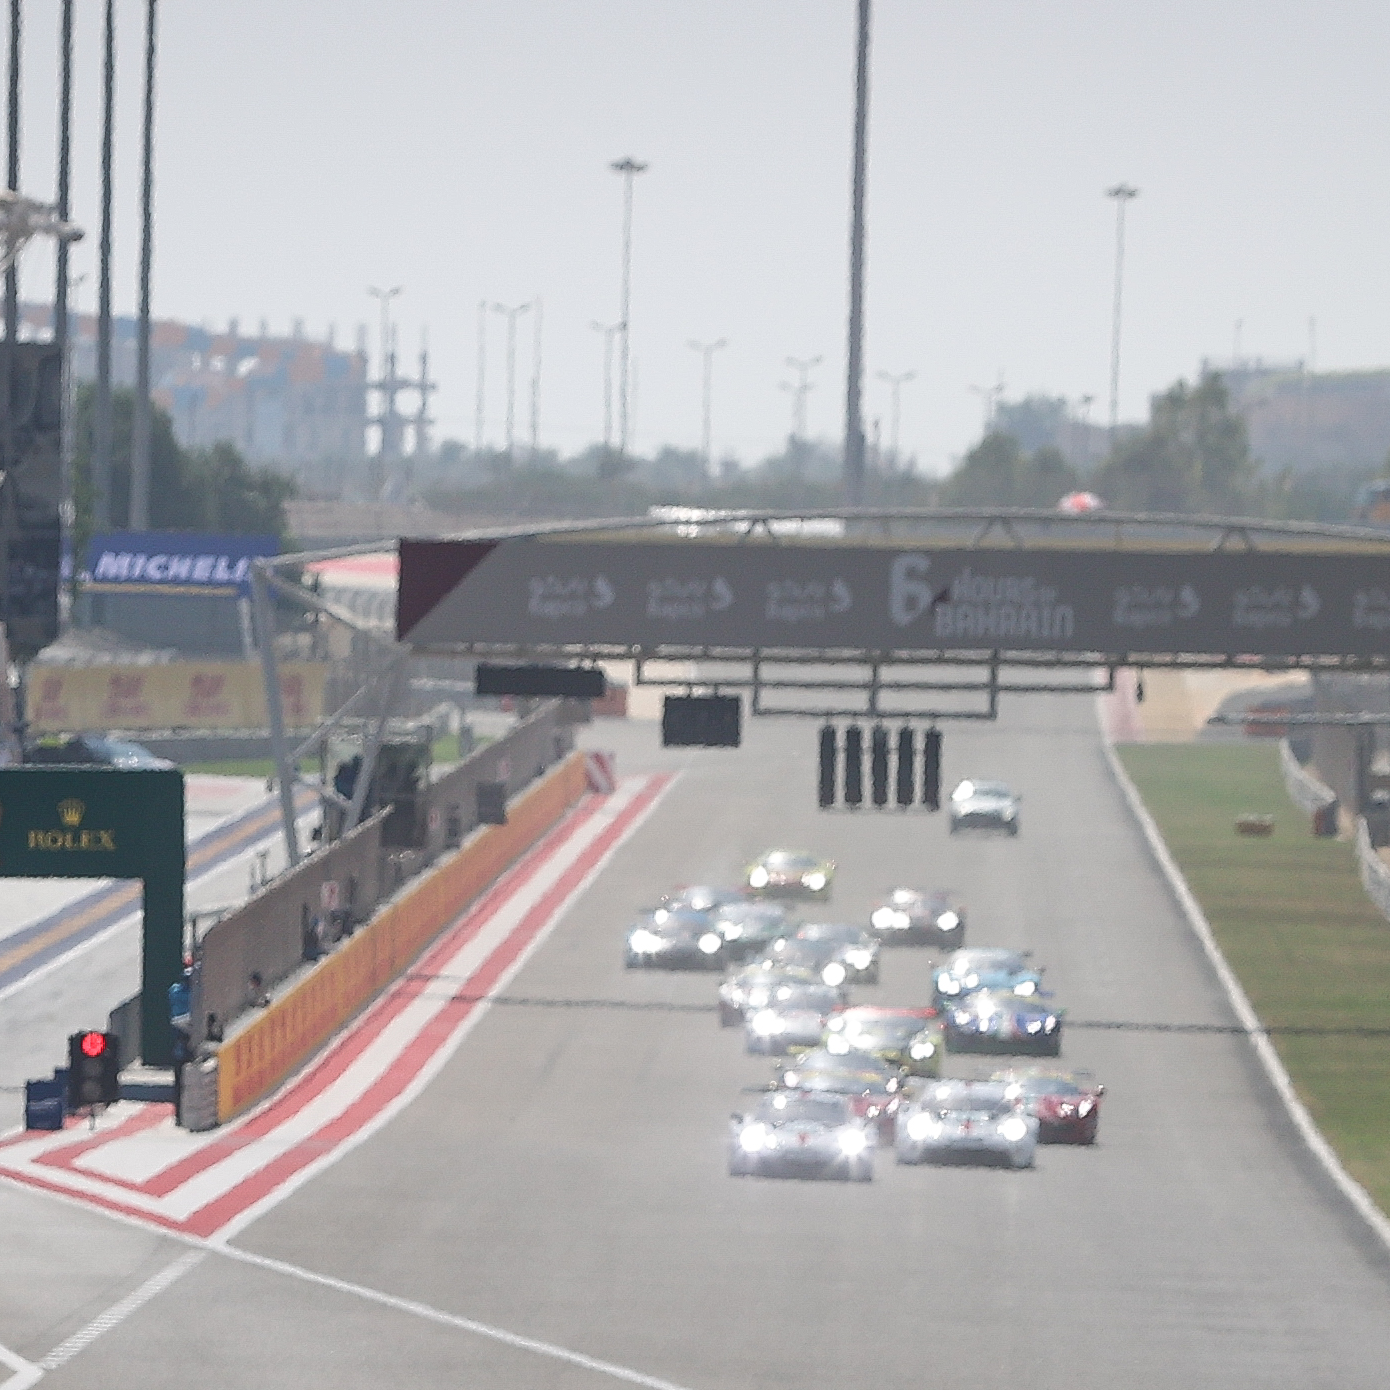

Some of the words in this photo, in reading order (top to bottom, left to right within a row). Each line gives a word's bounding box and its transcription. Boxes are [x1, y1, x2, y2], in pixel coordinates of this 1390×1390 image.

[95, 552, 250, 580] MICHELI
[890, 554, 933, 626] 6
[934, 603, 1076, 638] BAHRAIN
[27, 829, 115, 850] ROLEX
